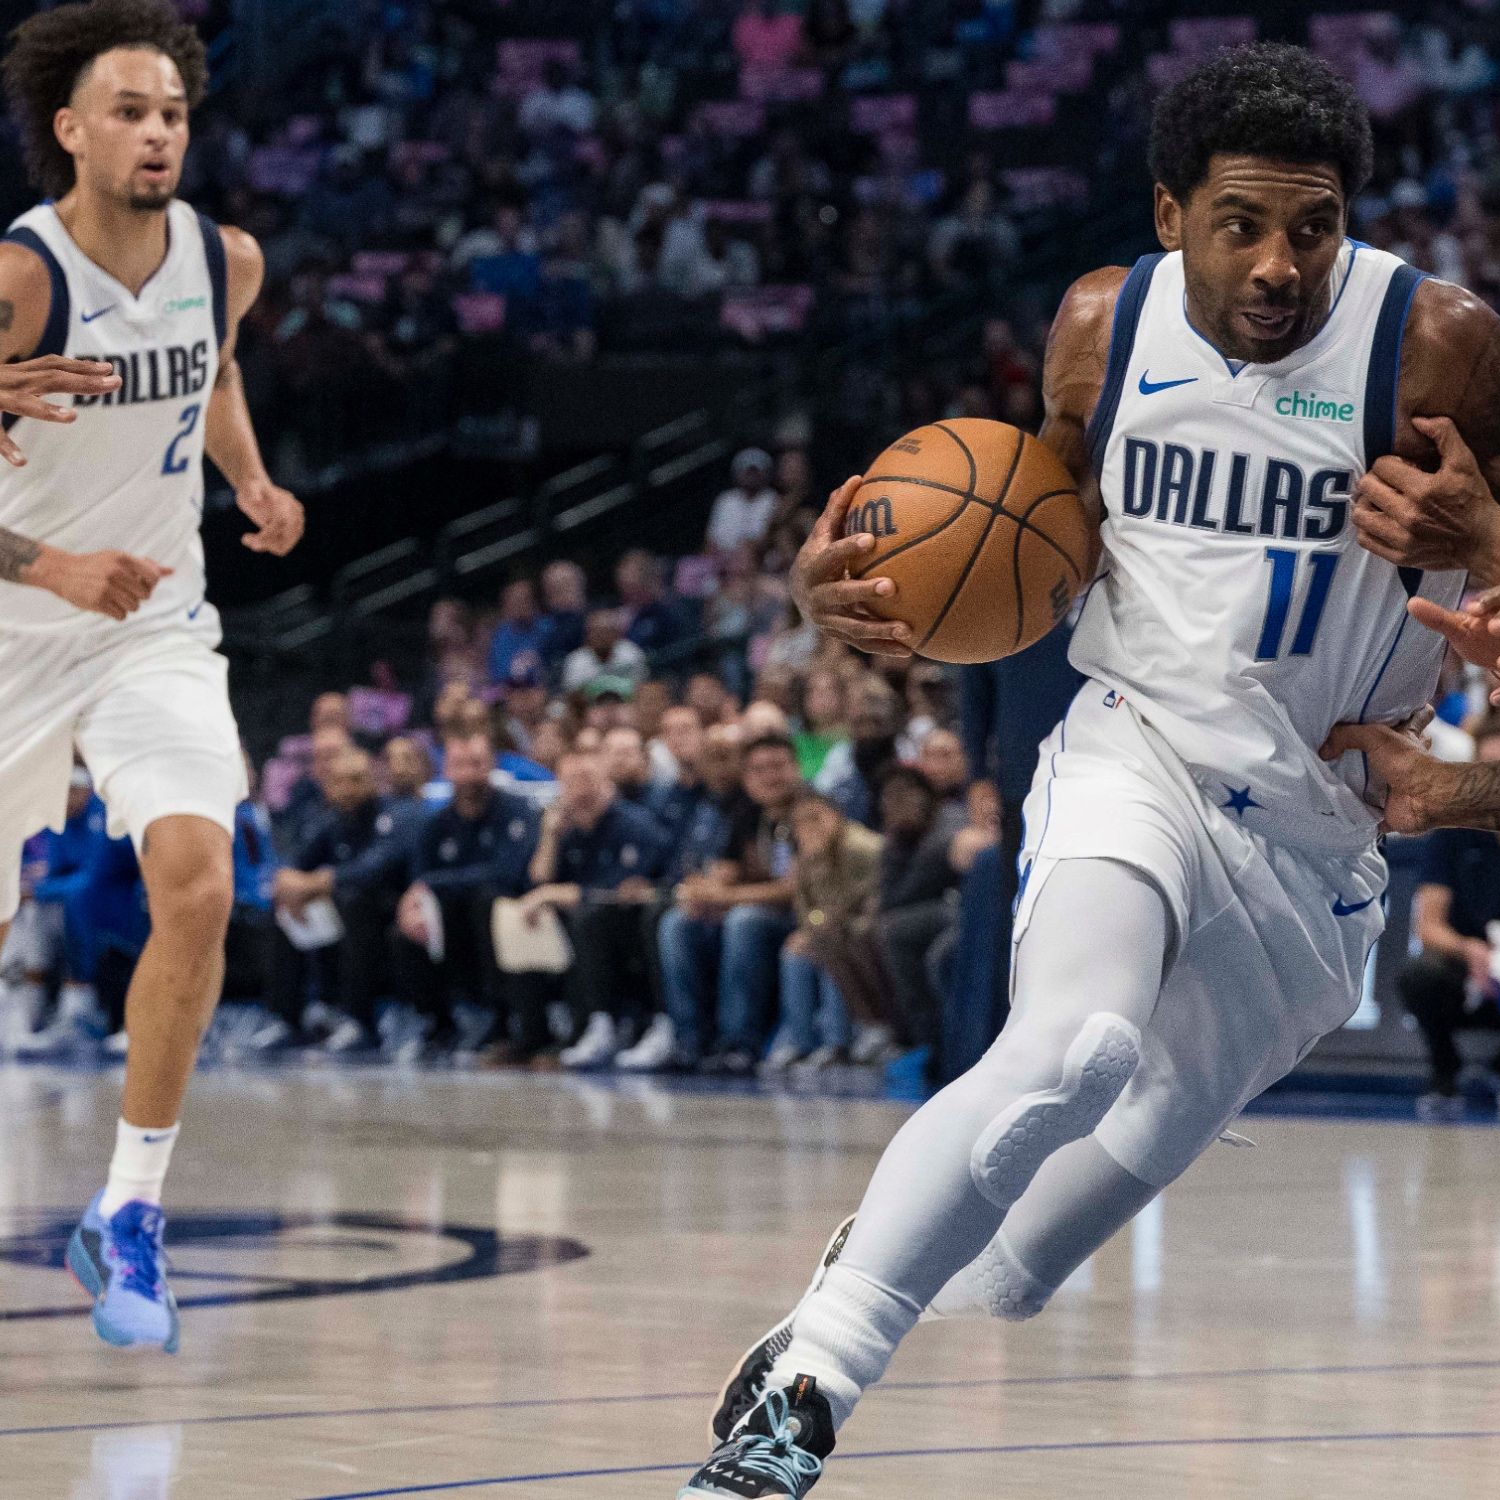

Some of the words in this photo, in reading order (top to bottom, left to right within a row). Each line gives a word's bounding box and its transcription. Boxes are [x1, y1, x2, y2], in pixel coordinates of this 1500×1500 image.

[161, 403, 201, 476] 2
[1275, 390, 1354, 422] chime
[1122, 434, 1354, 542] DALLAS
[1254, 546, 1341, 662] 11
